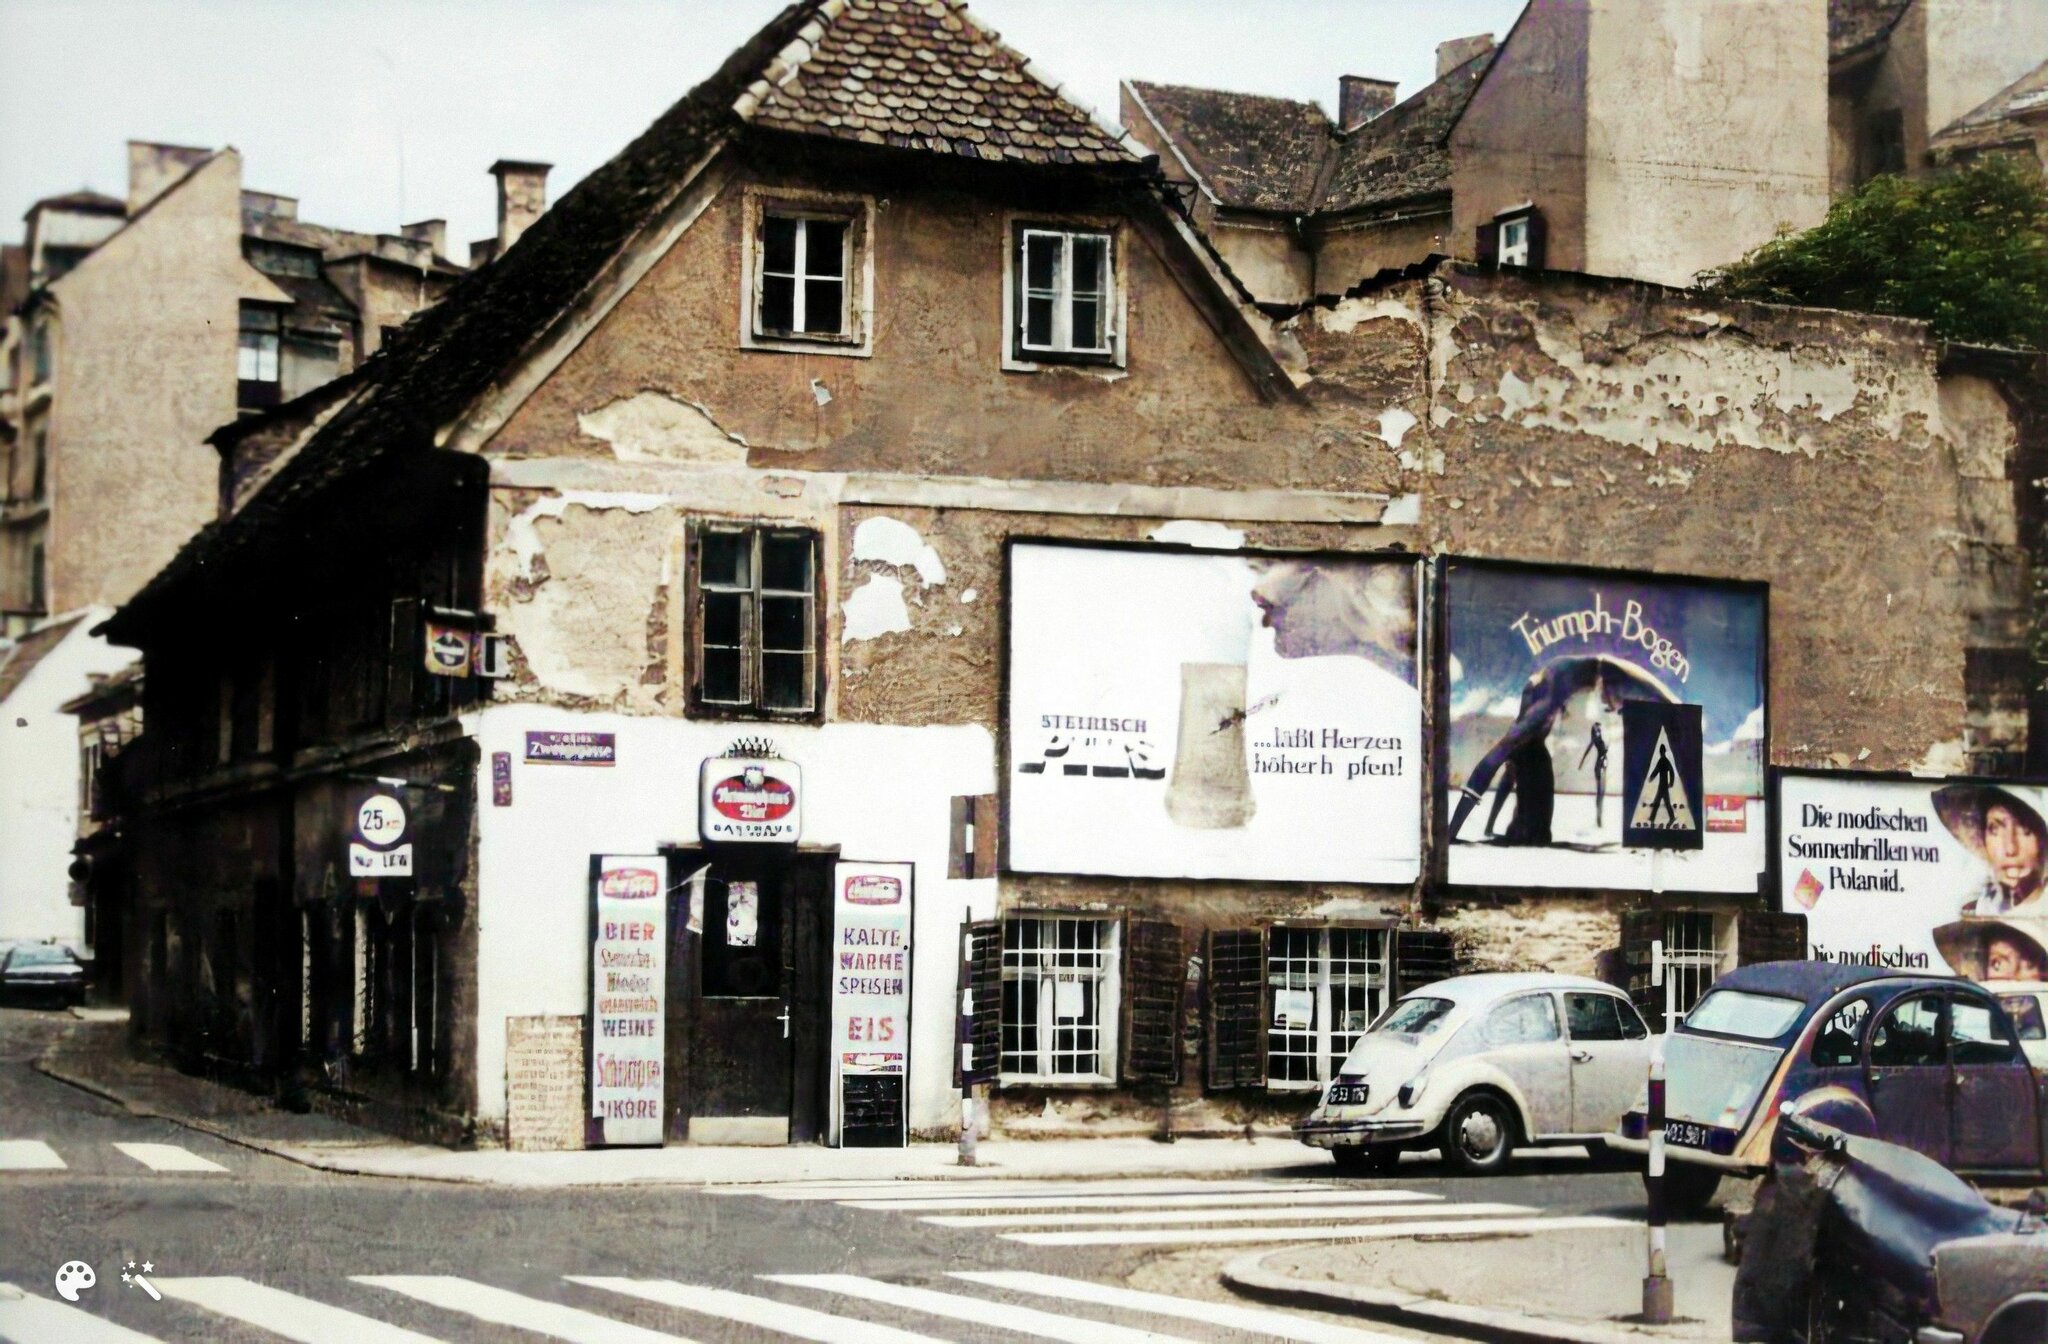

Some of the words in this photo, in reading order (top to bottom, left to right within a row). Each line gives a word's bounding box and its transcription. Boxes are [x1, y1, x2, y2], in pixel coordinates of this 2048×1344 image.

[1510, 592, 1690, 684] Triumph-Bogen
[1321, 728, 1402, 750] Herzen
[363, 809, 383, 830] 25
[1802, 803, 1833, 828] Die
[1838, 806, 1928, 832] modischen
[1788, 834, 1908, 862] Sonnenbrillen
[1911, 846, 1940, 863] von
[605, 922, 656, 941] BIER
[839, 976, 903, 995] SPEISEN
[847, 1016, 894, 1041] EIS
